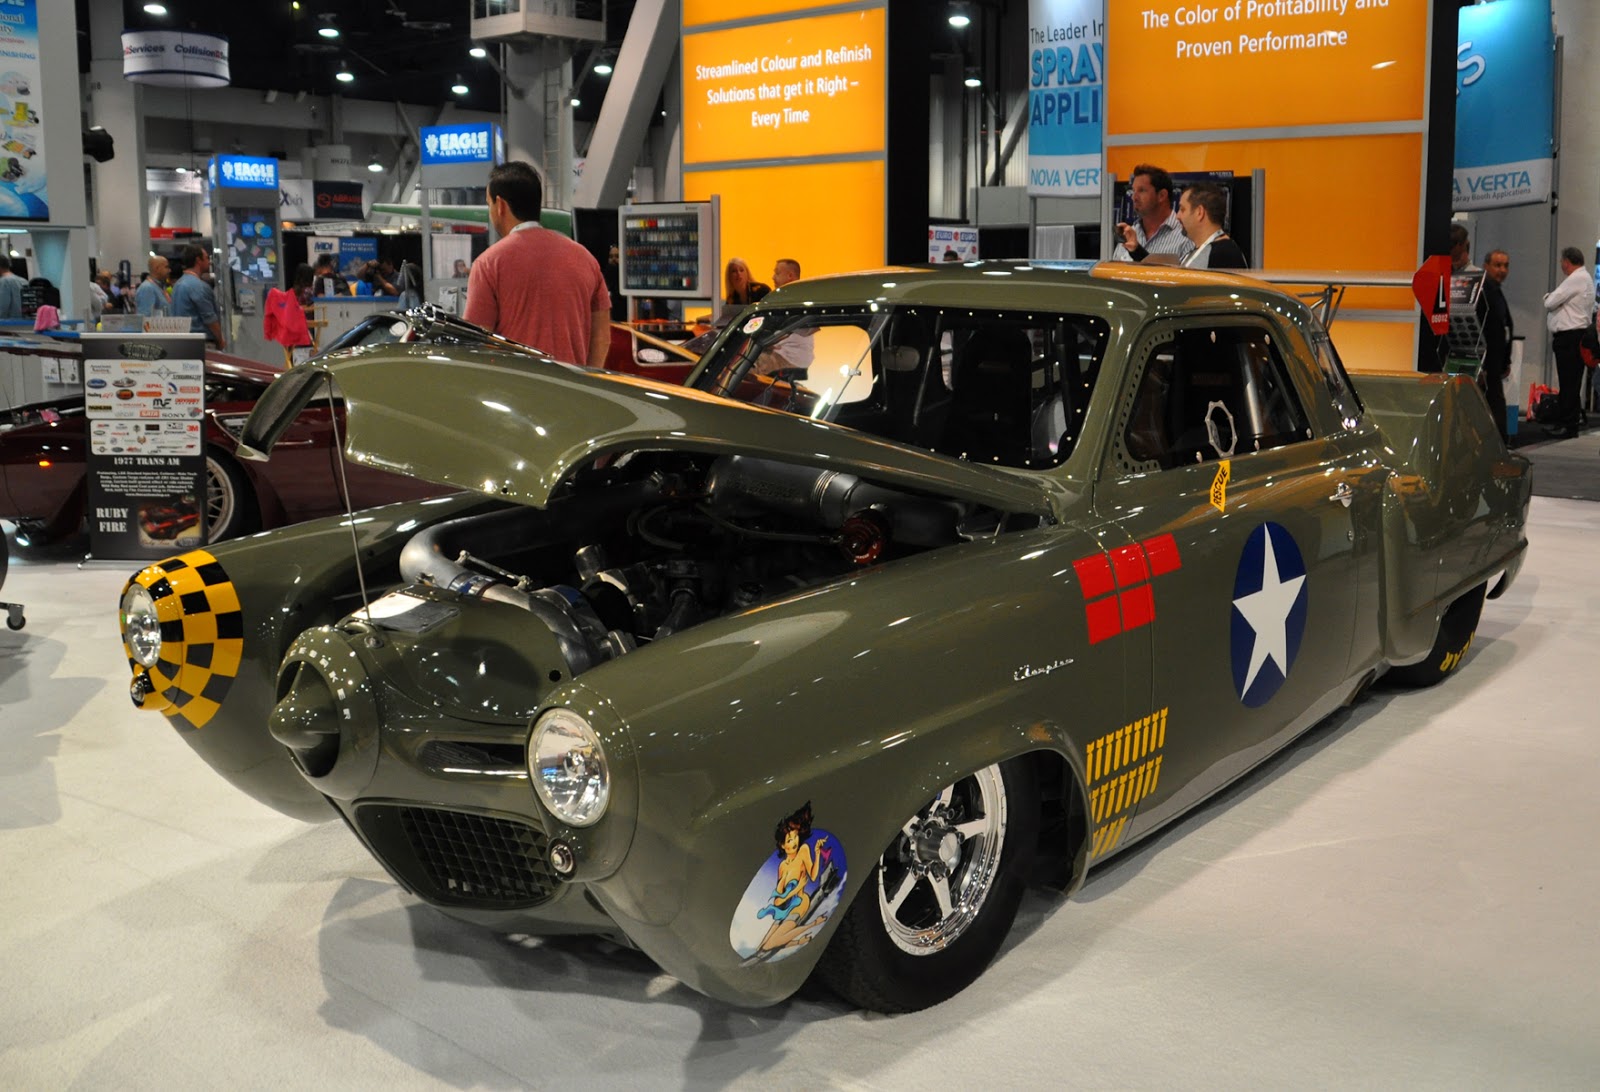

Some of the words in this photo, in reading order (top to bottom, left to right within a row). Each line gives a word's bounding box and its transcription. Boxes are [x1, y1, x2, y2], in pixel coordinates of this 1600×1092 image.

[1142, 10, 1169, 29] The
[1174, 5, 1218, 26] Color
[1223, 0, 1241, 21] of
[1246, 0, 1348, 19] Profitability
[1030, 28, 1045, 44] The
[1047, 23, 1088, 42] Leader
[1176, 40, 1232, 58] Proven
[1239, 30, 1348, 54] Performance
[695, 58, 759, 80] Streamlined
[760, 55, 798, 73] Colour
[799, 49, 822, 68] and
[825, 43, 872, 65] Refinish
[706, 87, 755, 105] Solutions
[758, 83, 781, 100] that
[783, 82, 802, 101] get
[805, 79, 814, 94] it
[816, 76, 848, 97] Right
[751, 110, 780, 129] Every
[783, 107, 810, 123] Time
[1031, 89, 1099, 127] APPLI
[439, 131, 488, 150] EAGLE
[440, 147, 488, 156] ABRASIVES
[233, 162, 274, 178] EAGLE
[1031, 169, 1061, 187] NOVA
[1065, 167, 1101, 187] VER
[1466, 170, 1531, 194] VERTA
[1471, 191, 1491, 201] Booth
[1492, 187, 1531, 200] Applications
[114, 457, 134, 465] 1977
[136, 457, 165, 466] TRANS
[167, 457, 180, 466] AM
[1213, 467, 1228, 507] RESCUE
[96, 507, 129, 519] RUBY
[99, 521, 127, 532] FIRE
